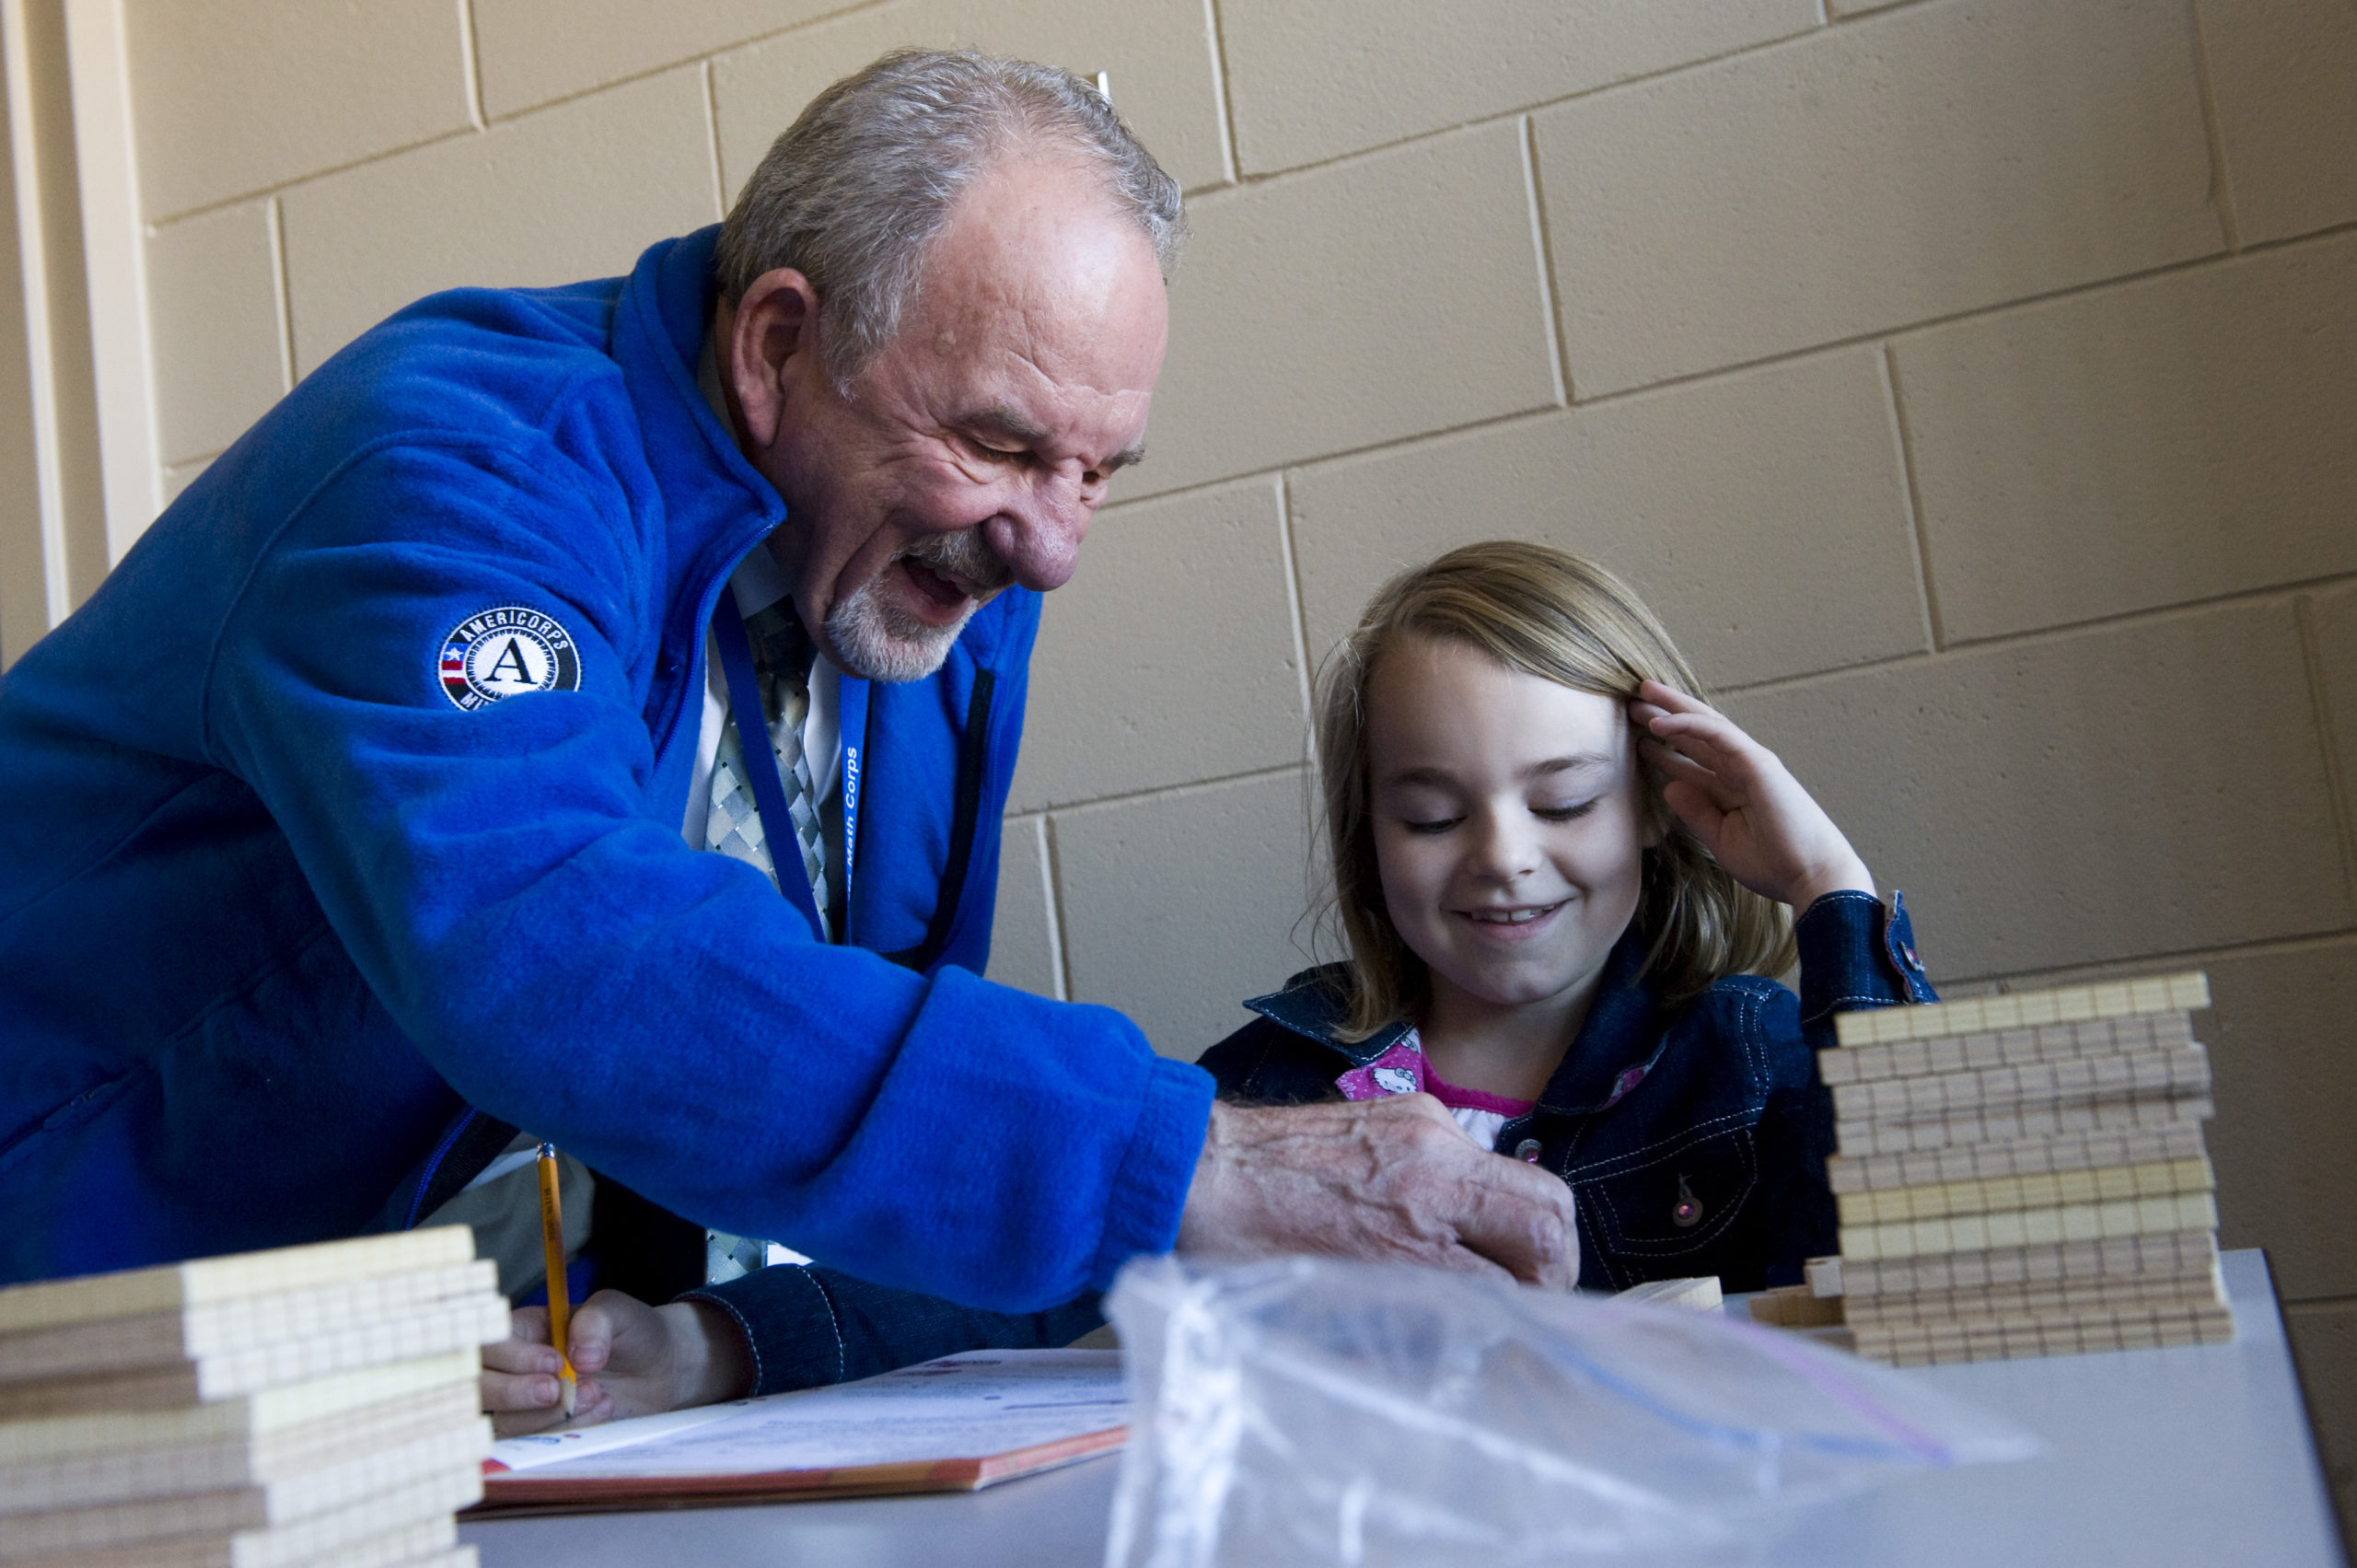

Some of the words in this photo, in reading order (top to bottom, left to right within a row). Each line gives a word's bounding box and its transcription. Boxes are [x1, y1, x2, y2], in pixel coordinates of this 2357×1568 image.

[459, 610, 569, 650] AMERICORPS
[483, 637, 539, 685] A
[846, 747, 859, 809] Corps
[846, 817, 854, 867] Math
